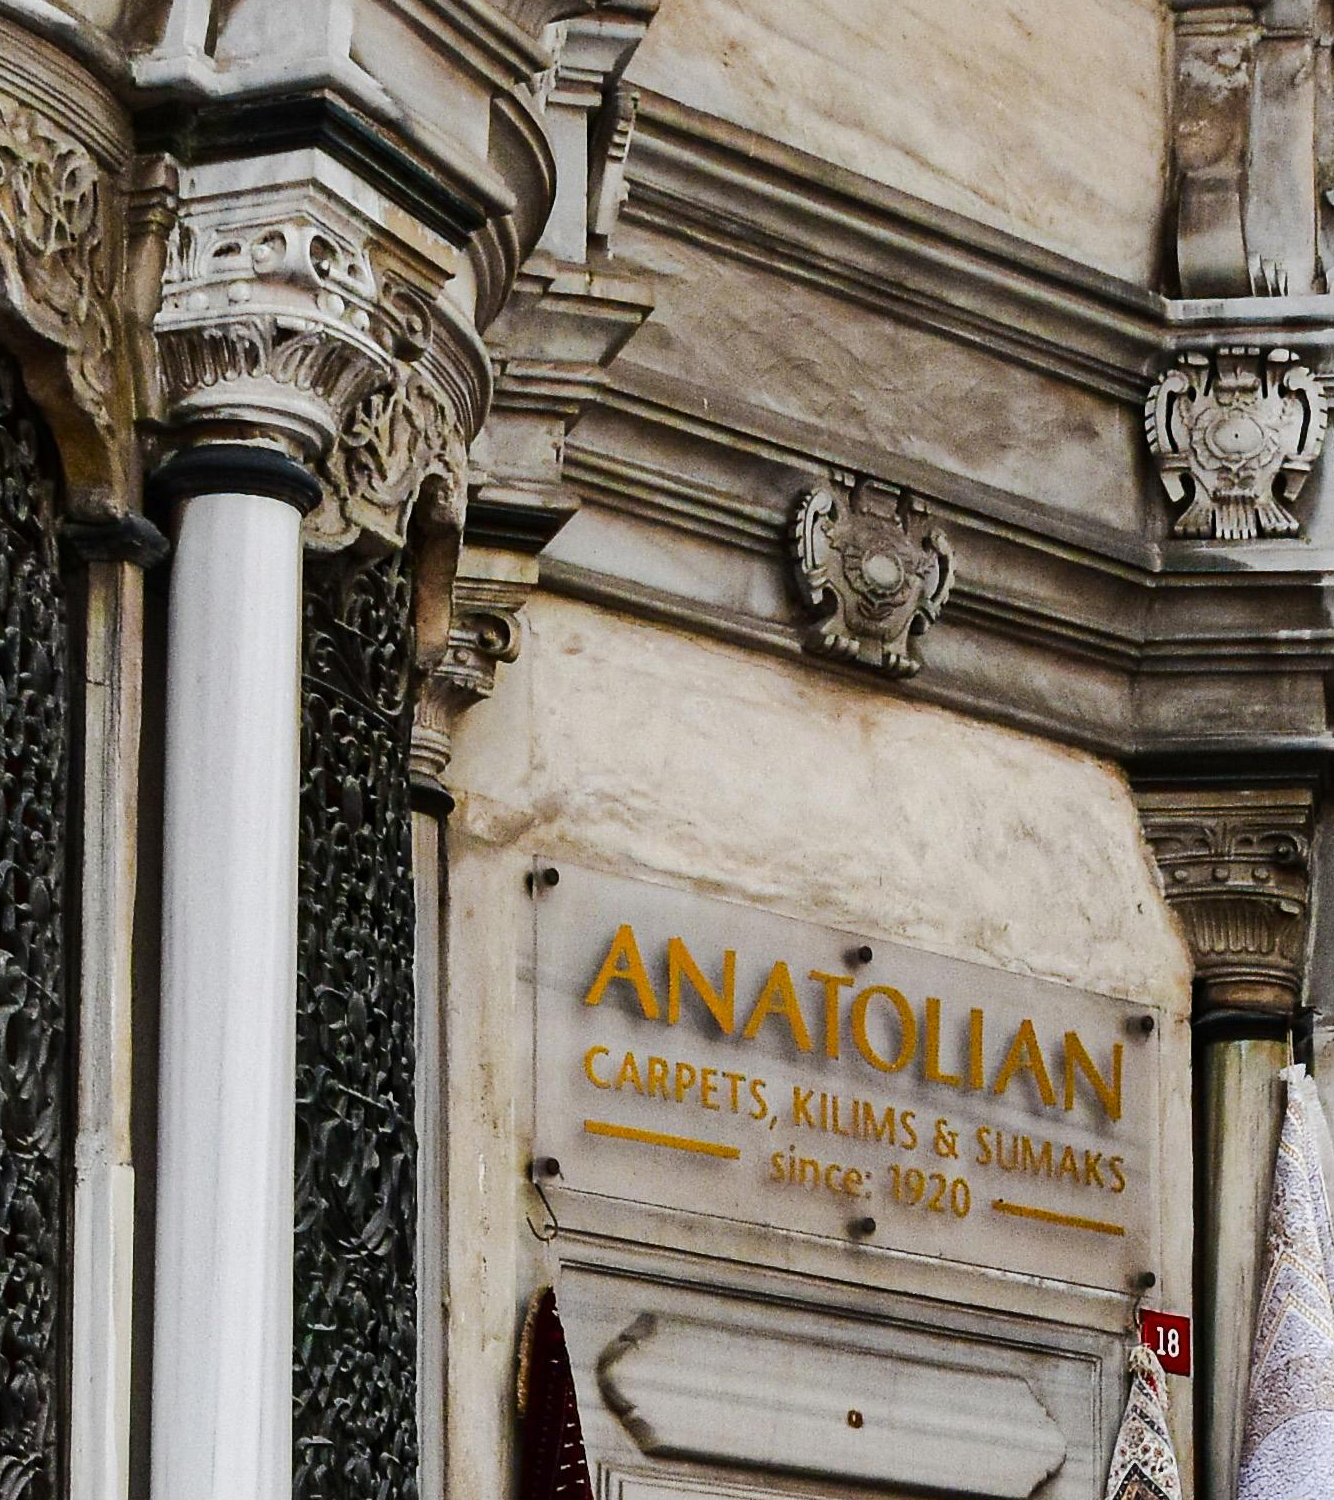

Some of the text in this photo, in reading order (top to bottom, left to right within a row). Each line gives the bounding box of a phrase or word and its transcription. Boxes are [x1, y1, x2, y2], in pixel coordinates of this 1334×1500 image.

[582, 923, 1125, 1123] ANATOLIAN
[582, 1044, 1126, 1194] CARPETS, KILIMS & SUMAKS
[769, 1143, 971, 1219] since: 1920
[1156, 1326, 1180, 1358] 18
